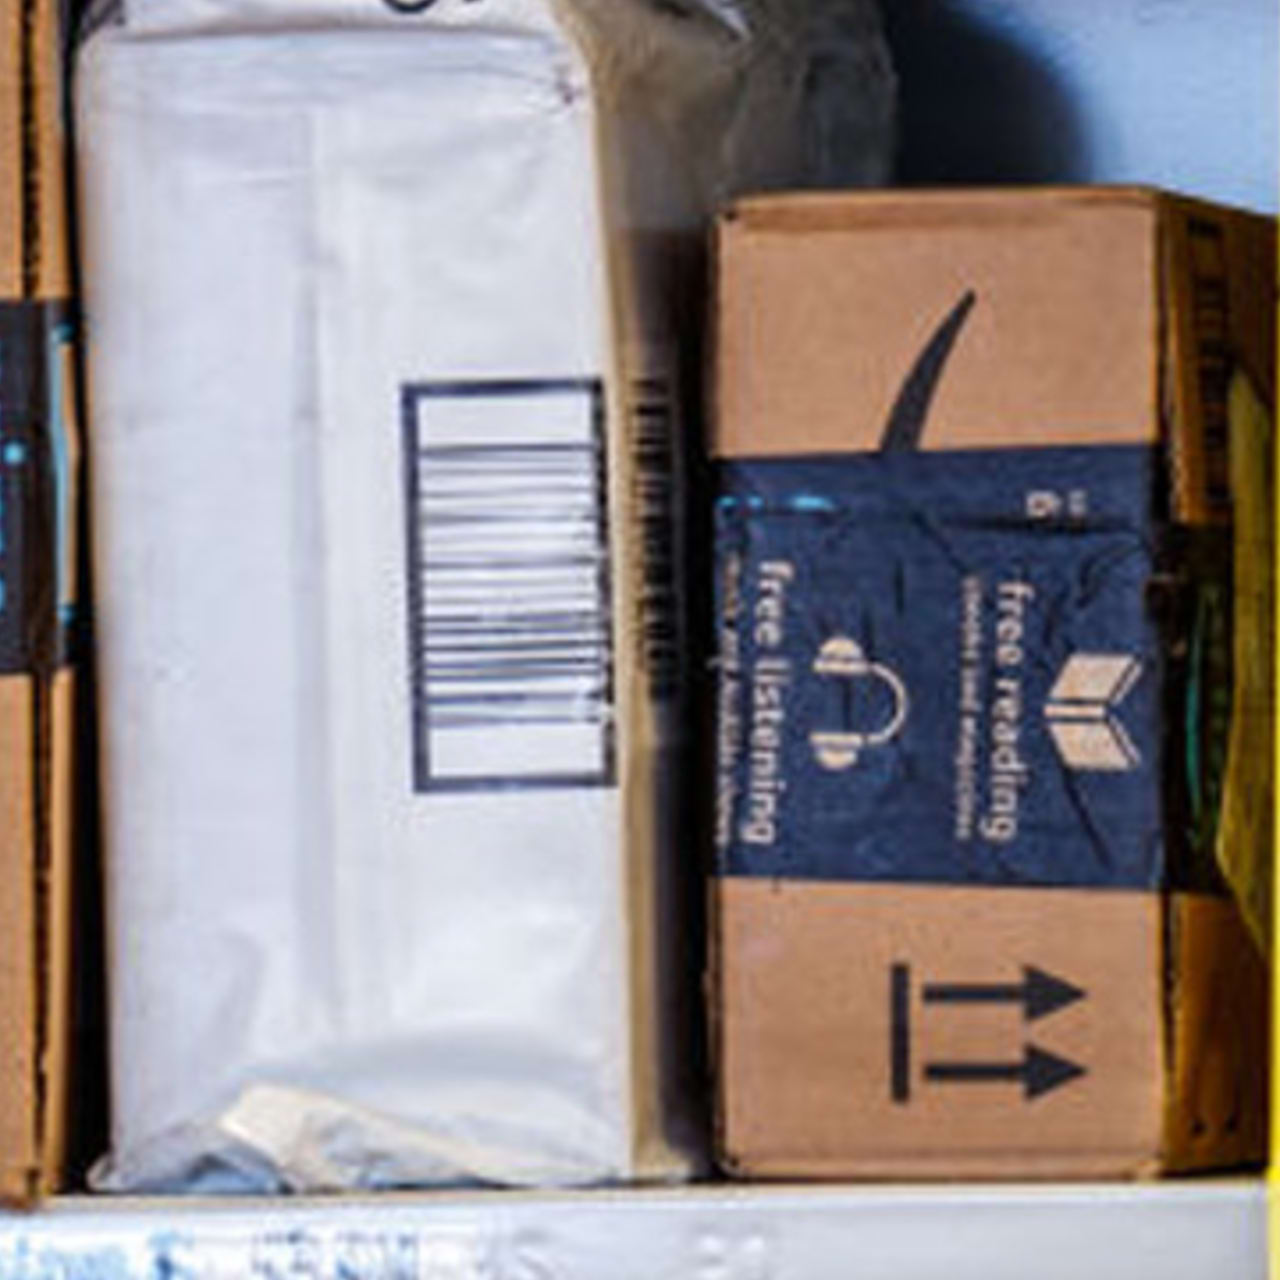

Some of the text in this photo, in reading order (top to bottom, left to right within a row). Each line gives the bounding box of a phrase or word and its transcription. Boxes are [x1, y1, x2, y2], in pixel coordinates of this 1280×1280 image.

[741, 558, 794, 846] free listening
[979, 579, 1033, 843] free reading
